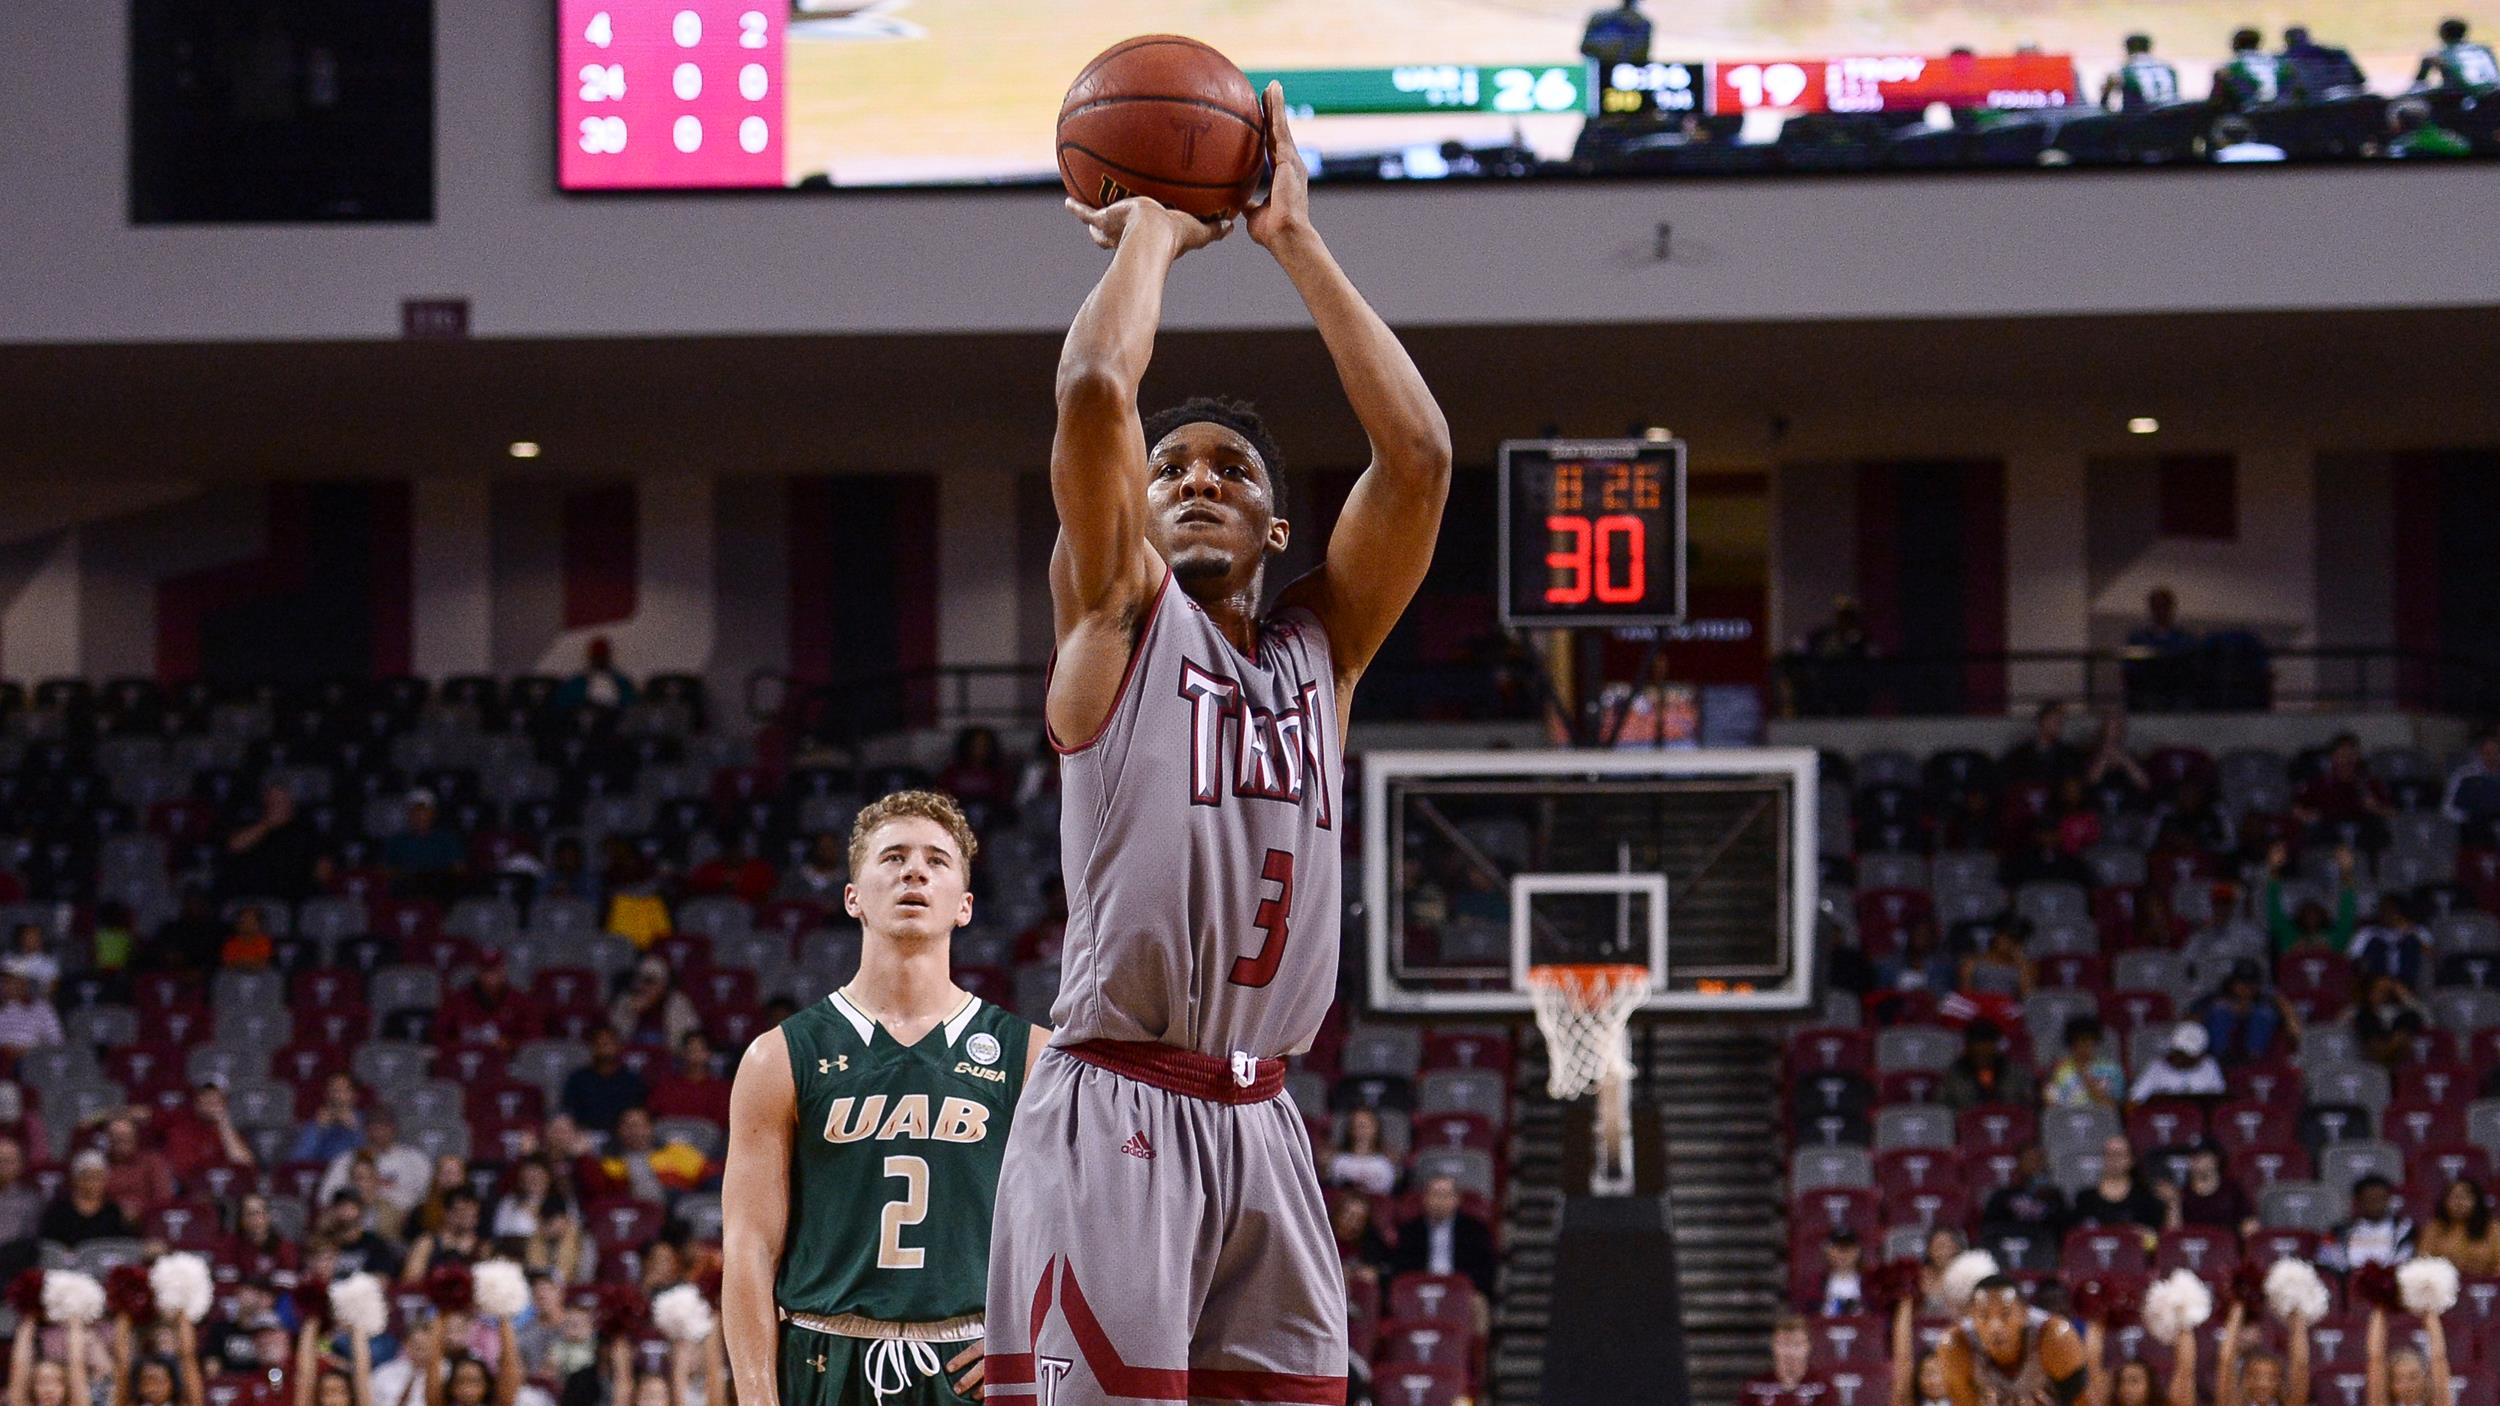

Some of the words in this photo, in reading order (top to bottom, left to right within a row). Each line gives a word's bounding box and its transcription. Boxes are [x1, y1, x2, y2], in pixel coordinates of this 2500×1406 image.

[584, 11, 613, 48] 4
[672, 10, 702, 47] 0
[739, 11, 768, 48] 2
[579, 63, 627, 101] 24
[673, 63, 702, 100] 0
[739, 63, 768, 101] 0
[1493, 69, 1577, 111] 26
[1727, 64, 1806, 106] 19
[579, 116, 627, 154] 30
[673, 115, 702, 153] 0
[739, 116, 768, 154] 0
[1545, 515, 1644, 603] 30
[1228, 848, 1294, 988] 3
[823, 1094, 990, 1143] UAB
[1120, 1145, 1157, 1159] adidas
[877, 1155, 930, 1268] 2
[1039, 1355, 1074, 1406] T
